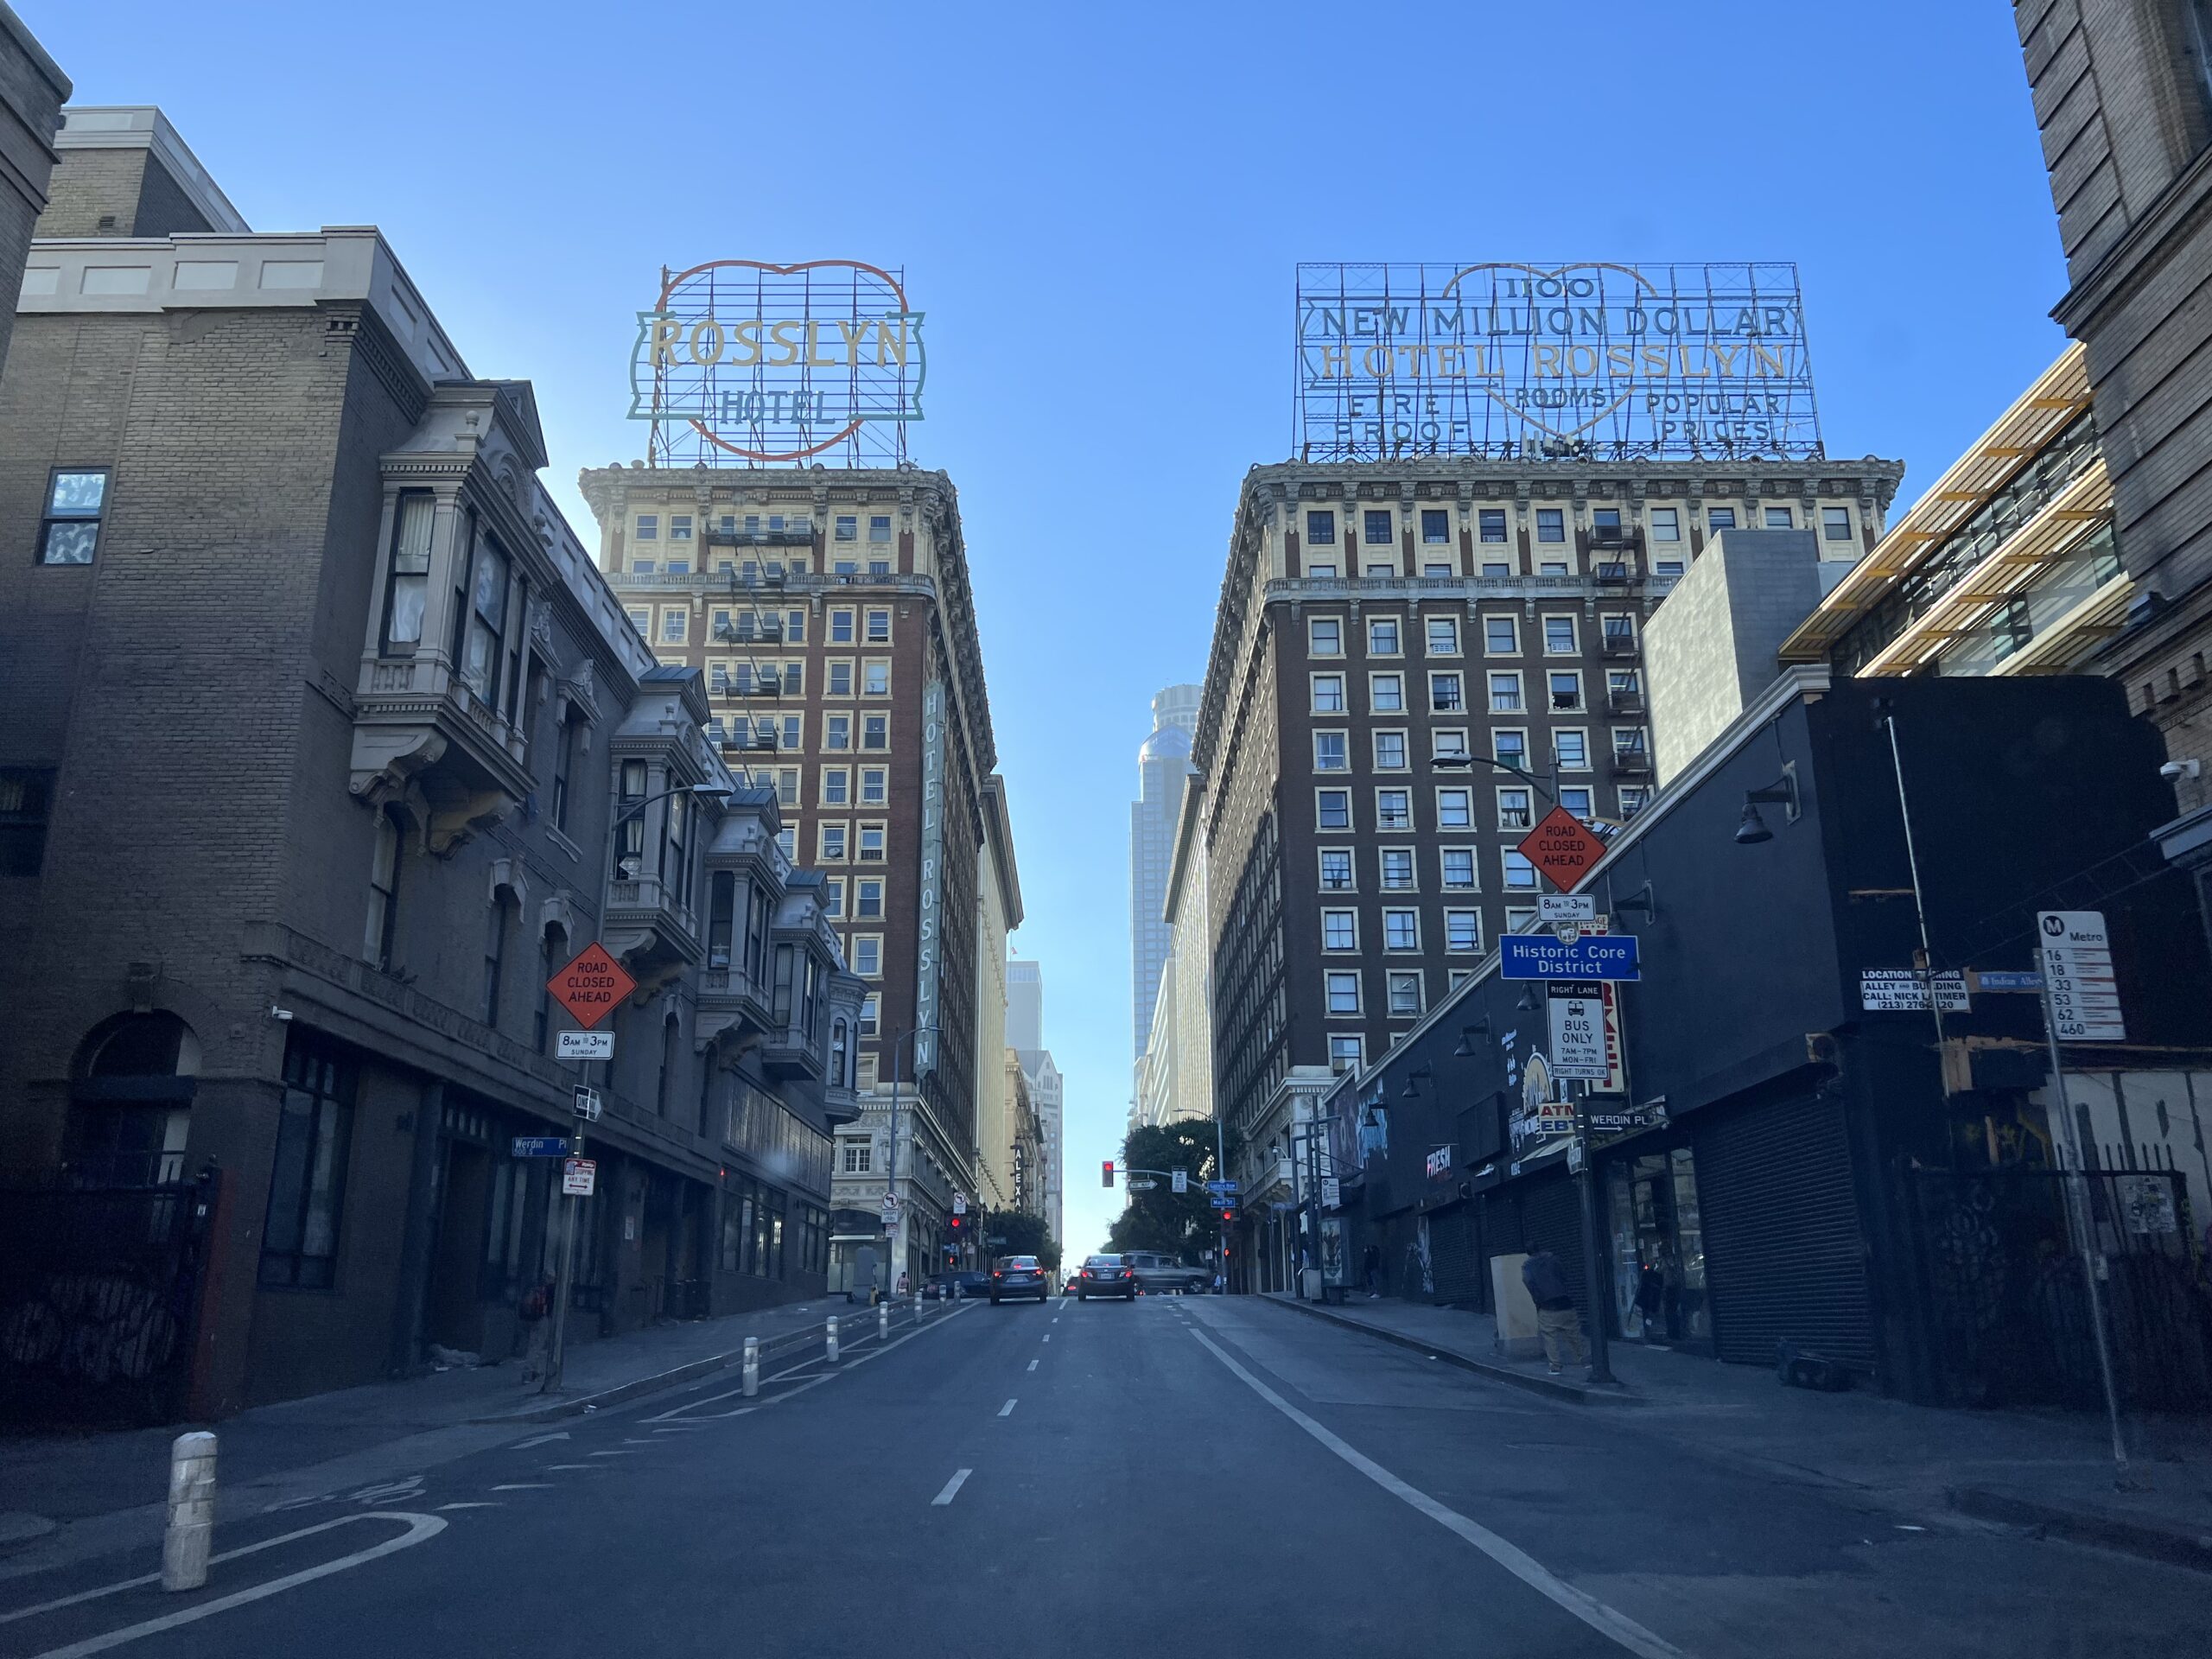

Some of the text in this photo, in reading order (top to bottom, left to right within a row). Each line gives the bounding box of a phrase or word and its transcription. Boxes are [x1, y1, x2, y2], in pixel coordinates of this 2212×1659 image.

[1322, 306, 1788, 336] NEW MILLION DOLLAR
[648, 320, 907, 367] ROSSLYN
[1321, 344, 1784, 378] HOTEL ROSSLYN
[1515, 387, 1606, 409] ROOMS
[1646, 393, 1780, 414] POPULAR
[720, 390, 836, 424] HOTEL
[1350, 393, 1440, 416] FIRE
[1335, 420, 1469, 442] PROOF
[1661, 420, 1770, 442] PRICES
[1546, 825, 1576, 836] ROAD
[1539, 840, 1586, 851] CLOSED
[1543, 855, 1584, 866] AHEAD
[917, 695, 938, 1066] HOTEL ROSSLYN
[1543, 899, 1561, 909] 8AM
[1571, 899, 1589, 909] 3PM
[2070, 931, 2103, 943] Metro
[1513, 944, 1626, 959] Historic Core
[2046, 950, 2062, 961] 16
[577, 962, 608, 974] ROAD
[1538, 960, 1603, 974] District
[2050, 964, 2065, 976] 18
[1862, 970, 1912, 980] LOCATION
[567, 976, 615, 988] CLOSED
[2055, 979, 2071, 990] 33
[1551, 985, 1574, 995] RIGHT
[568, 991, 612, 1003] AHEAD
[1863, 992, 1892, 1001] CALL:
[1894, 992, 1918, 1001] NICK
[2055, 994, 2071, 1006] 53
[1878, 1001, 1904, 1009] (213)
[2057, 1008, 2075, 1020] 62
[1565, 1020, 1590, 1032] BUS
[2060, 1023, 2085, 1035] 460
[563, 1035, 581, 1046] 8AM
[589, 1035, 608, 1046] 3PM
[1562, 1033, 1593, 1044] ONLY
[1575, 1067, 1595, 1076] TURNS
[1591, 1114, 1648, 1126] WERDIN PL
[515, 1138, 544, 1148] Werdin
[1427, 1145, 1451, 1179] FRESH
